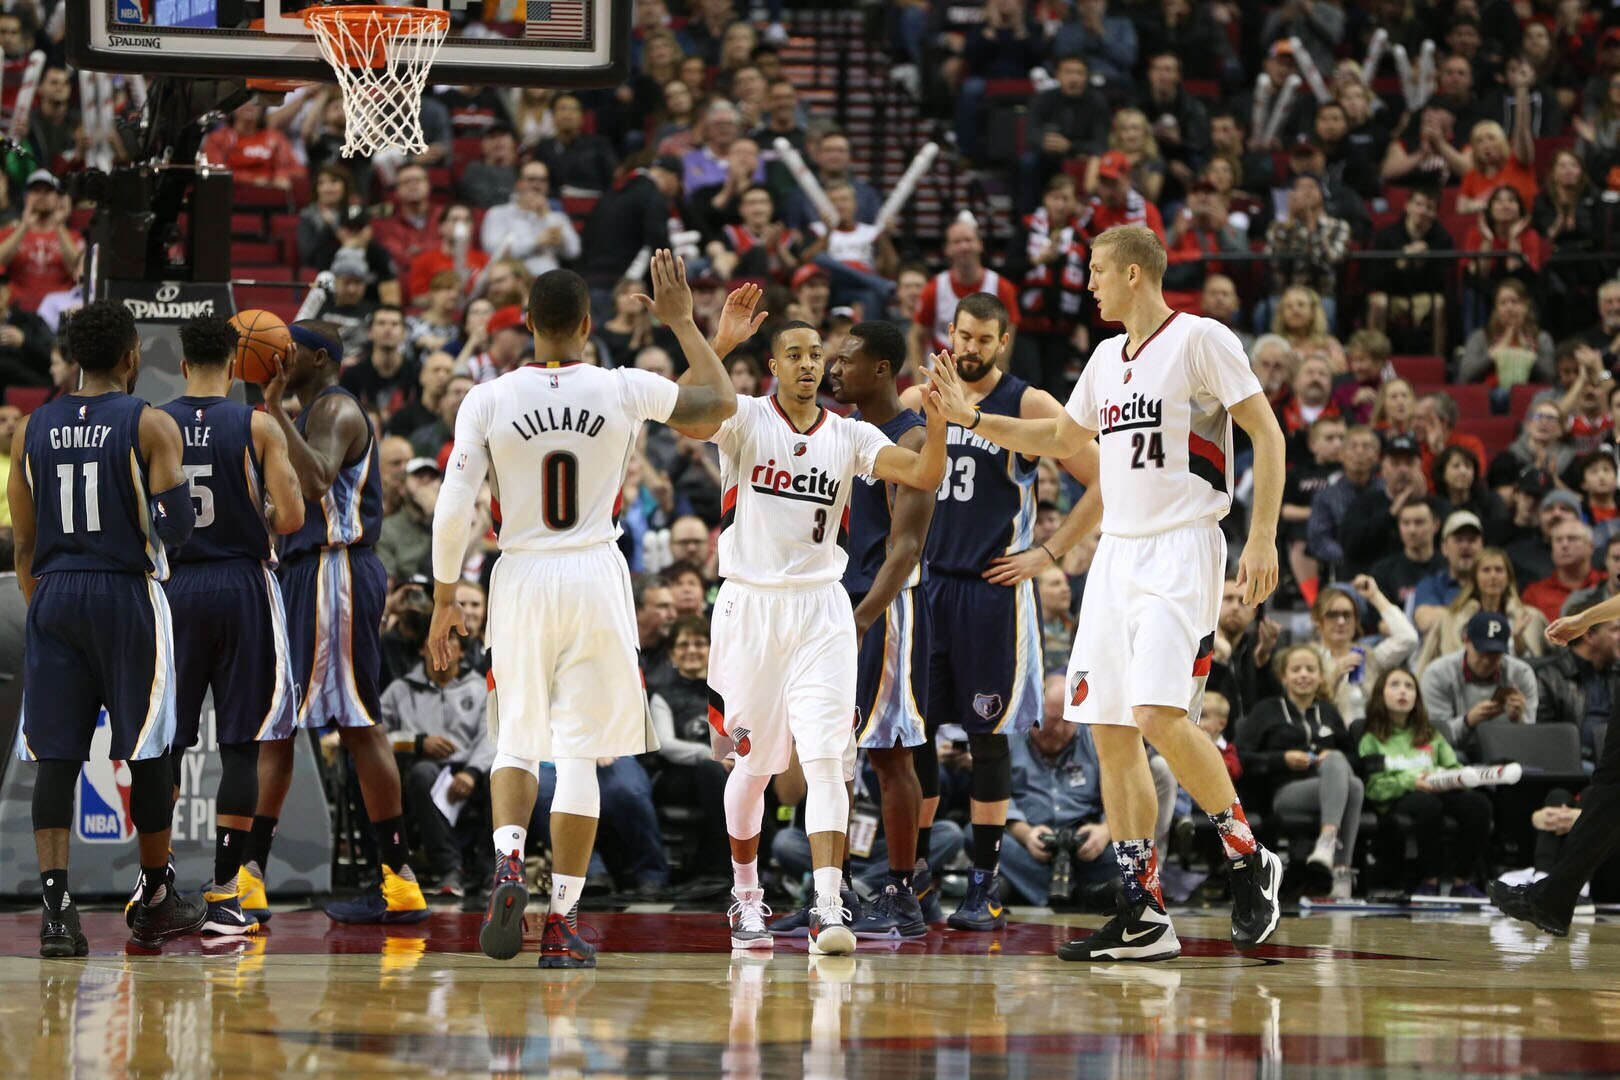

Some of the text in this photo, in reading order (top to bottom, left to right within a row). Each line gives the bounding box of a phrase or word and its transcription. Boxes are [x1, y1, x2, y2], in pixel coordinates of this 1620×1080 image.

[121, 8, 138, 19] NBA
[108, 35, 161, 49] SPALDING
[123, 298, 214, 319] SPALDING
[50, 424, 112, 450] CONLEY
[184, 425, 211, 448] LEE
[512, 407, 605, 441] LILLARD
[1131, 432, 1165, 469] 24
[182, 464, 215, 528] 5
[541, 450, 579, 532] 0
[750, 459, 841, 504] ripcity
[57, 461, 101, 534] 11
[812, 508, 827, 544] 3
[1487, 620, 1502, 638] P
[84, 814, 119, 835] NBA
